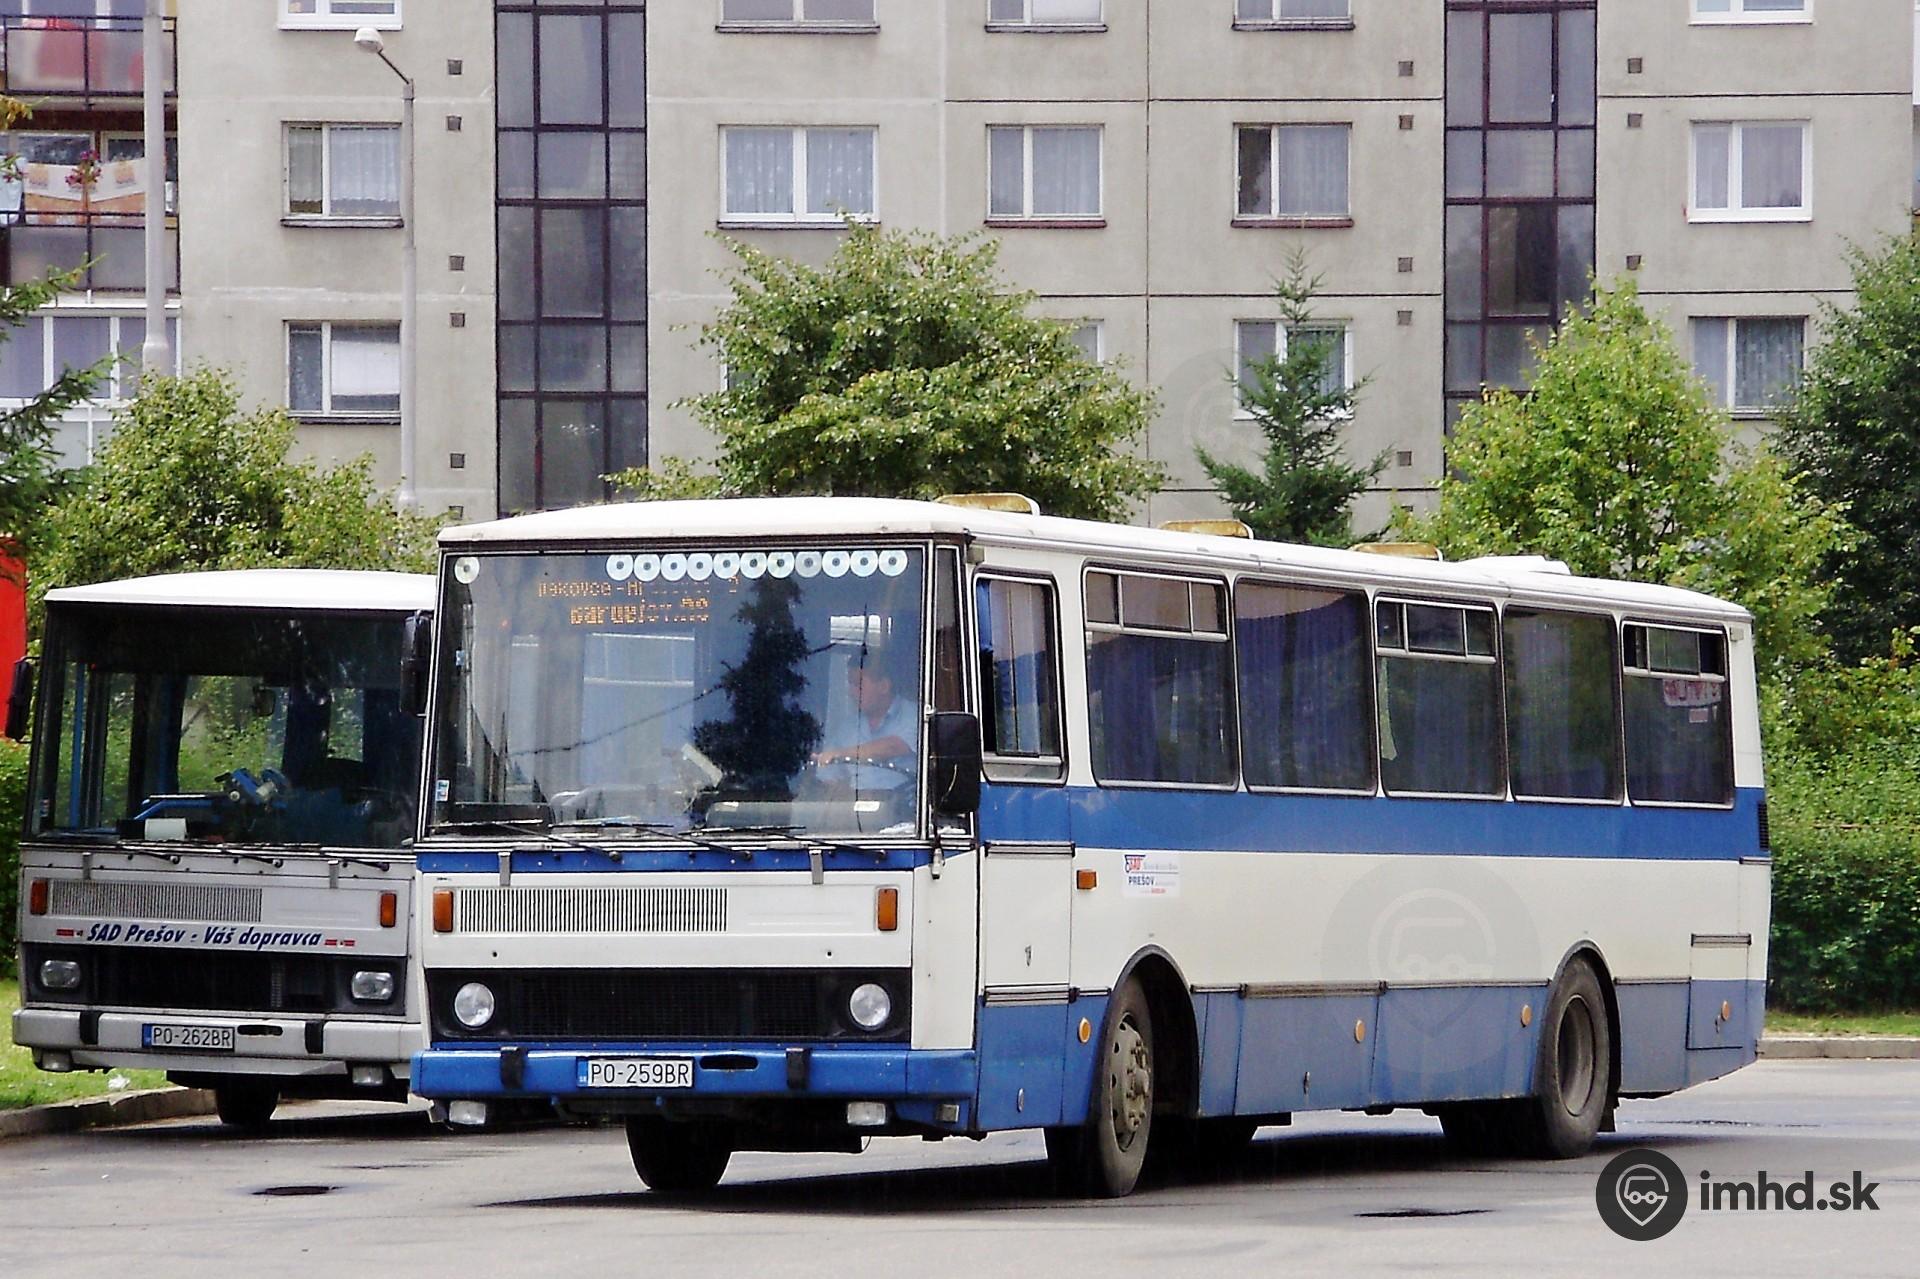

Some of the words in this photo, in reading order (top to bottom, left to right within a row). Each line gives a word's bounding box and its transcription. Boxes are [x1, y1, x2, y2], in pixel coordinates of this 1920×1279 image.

[87, 923, 121, 942] SAD
[125, 924, 186, 943] Prešov
[204, 926, 236, 944] Váš
[238, 928, 322, 951] dopravca
[153, 1026, 231, 1048] PO-262BR
[591, 1063, 689, 1084] PO-259BR
